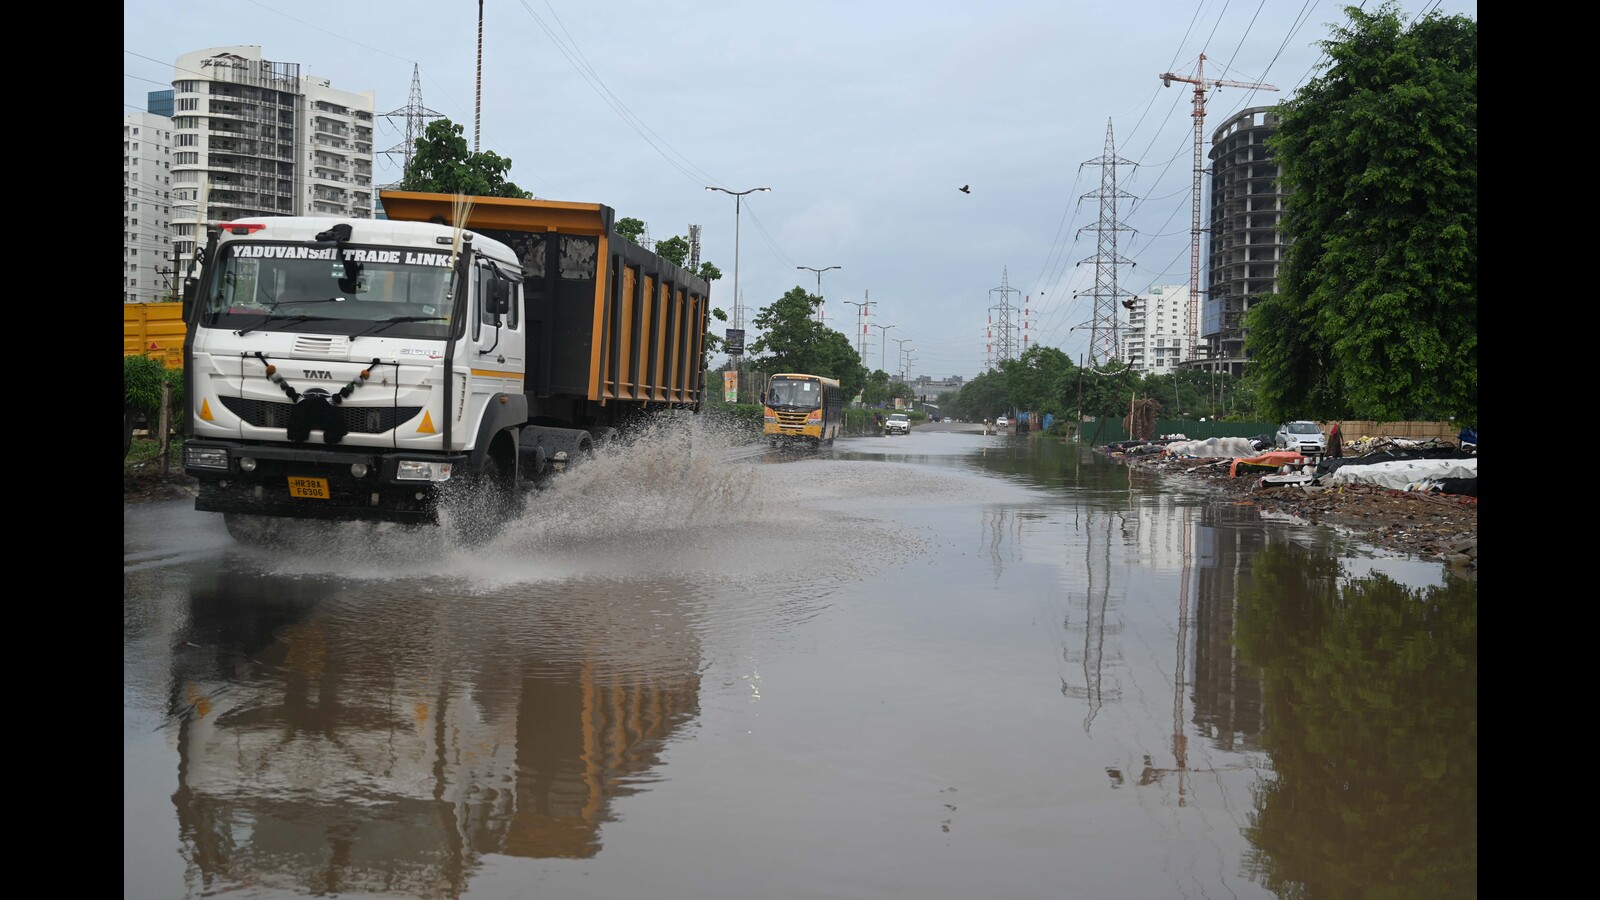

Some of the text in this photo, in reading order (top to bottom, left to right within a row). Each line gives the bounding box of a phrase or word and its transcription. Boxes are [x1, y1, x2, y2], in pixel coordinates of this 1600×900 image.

[200, 59, 213, 68] The
[232, 245, 338, 260] YADUVANSHI
[343, 249, 400, 263] TRADE
[303, 370, 332, 379] TATA
[295, 480, 321, 488] HR38A
[297, 488, 323, 496] F6306
